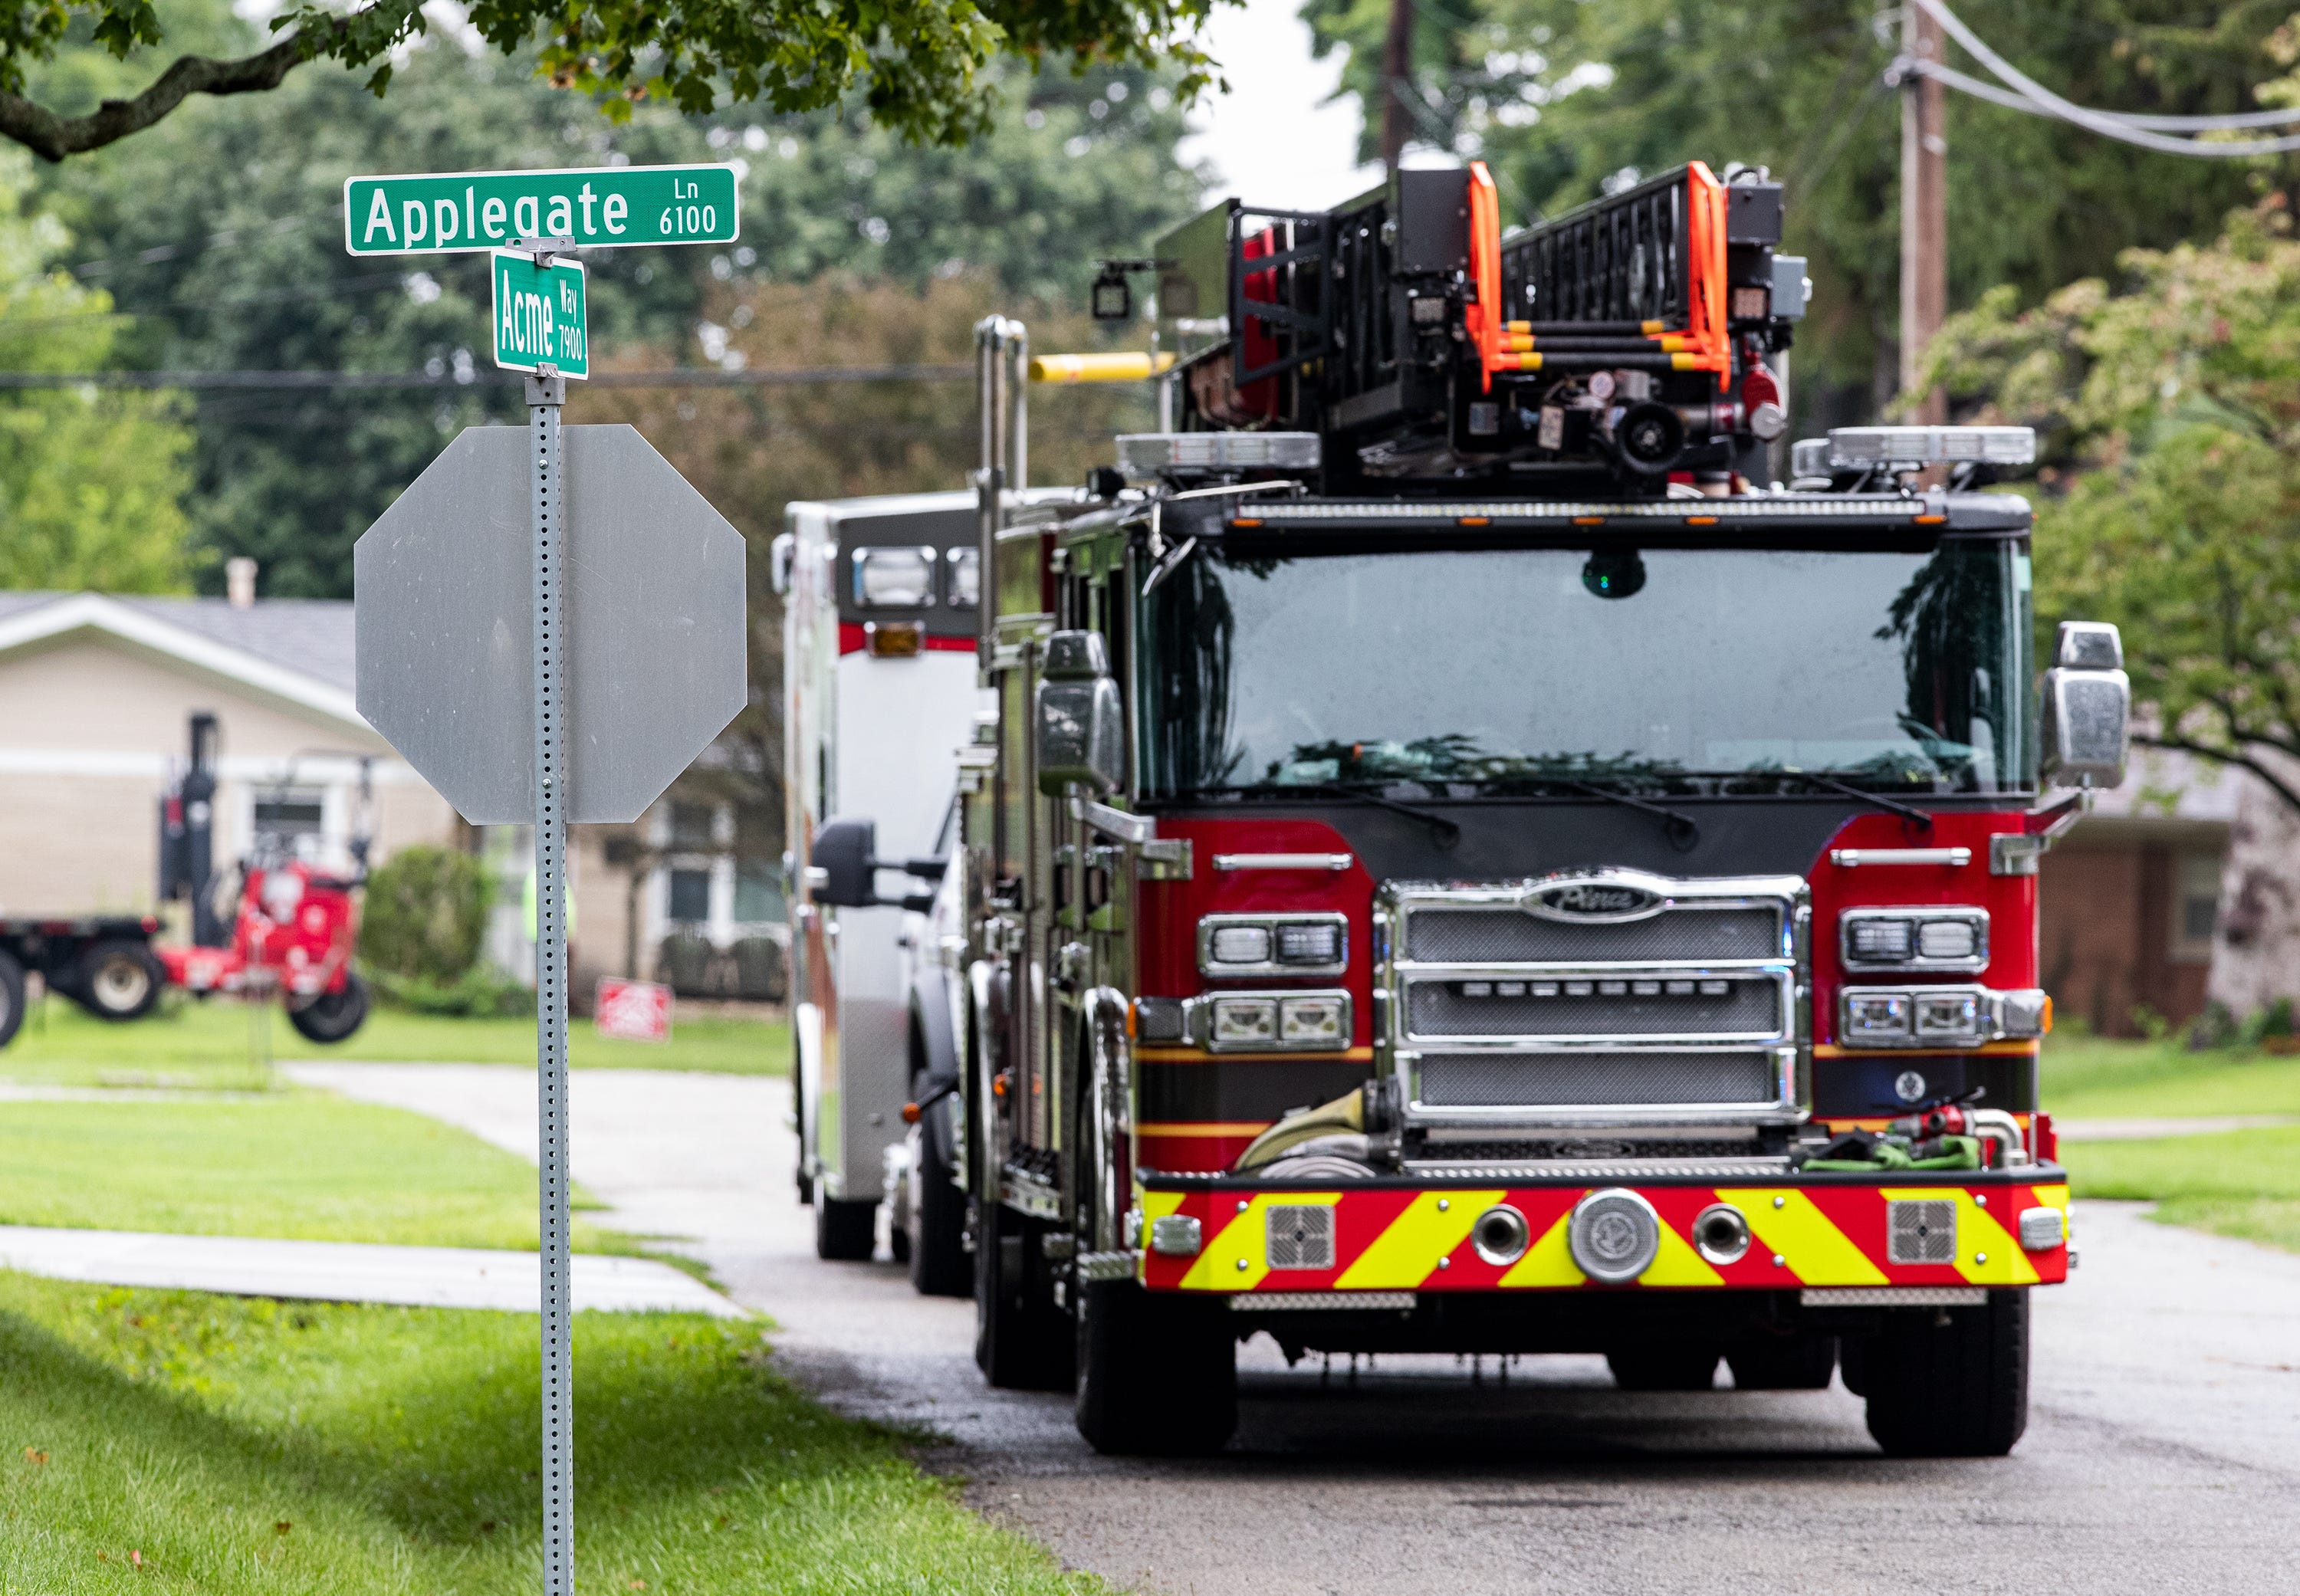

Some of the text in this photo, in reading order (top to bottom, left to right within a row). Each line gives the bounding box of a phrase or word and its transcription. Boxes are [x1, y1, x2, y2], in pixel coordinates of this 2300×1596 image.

[675, 178, 698, 199] Ln
[363, 182, 629, 250] Applegate
[659, 205, 716, 235] 6100
[501, 269, 554, 357] Acme
[560, 279, 577, 324] Way
[558, 324, 583, 361] 7900
